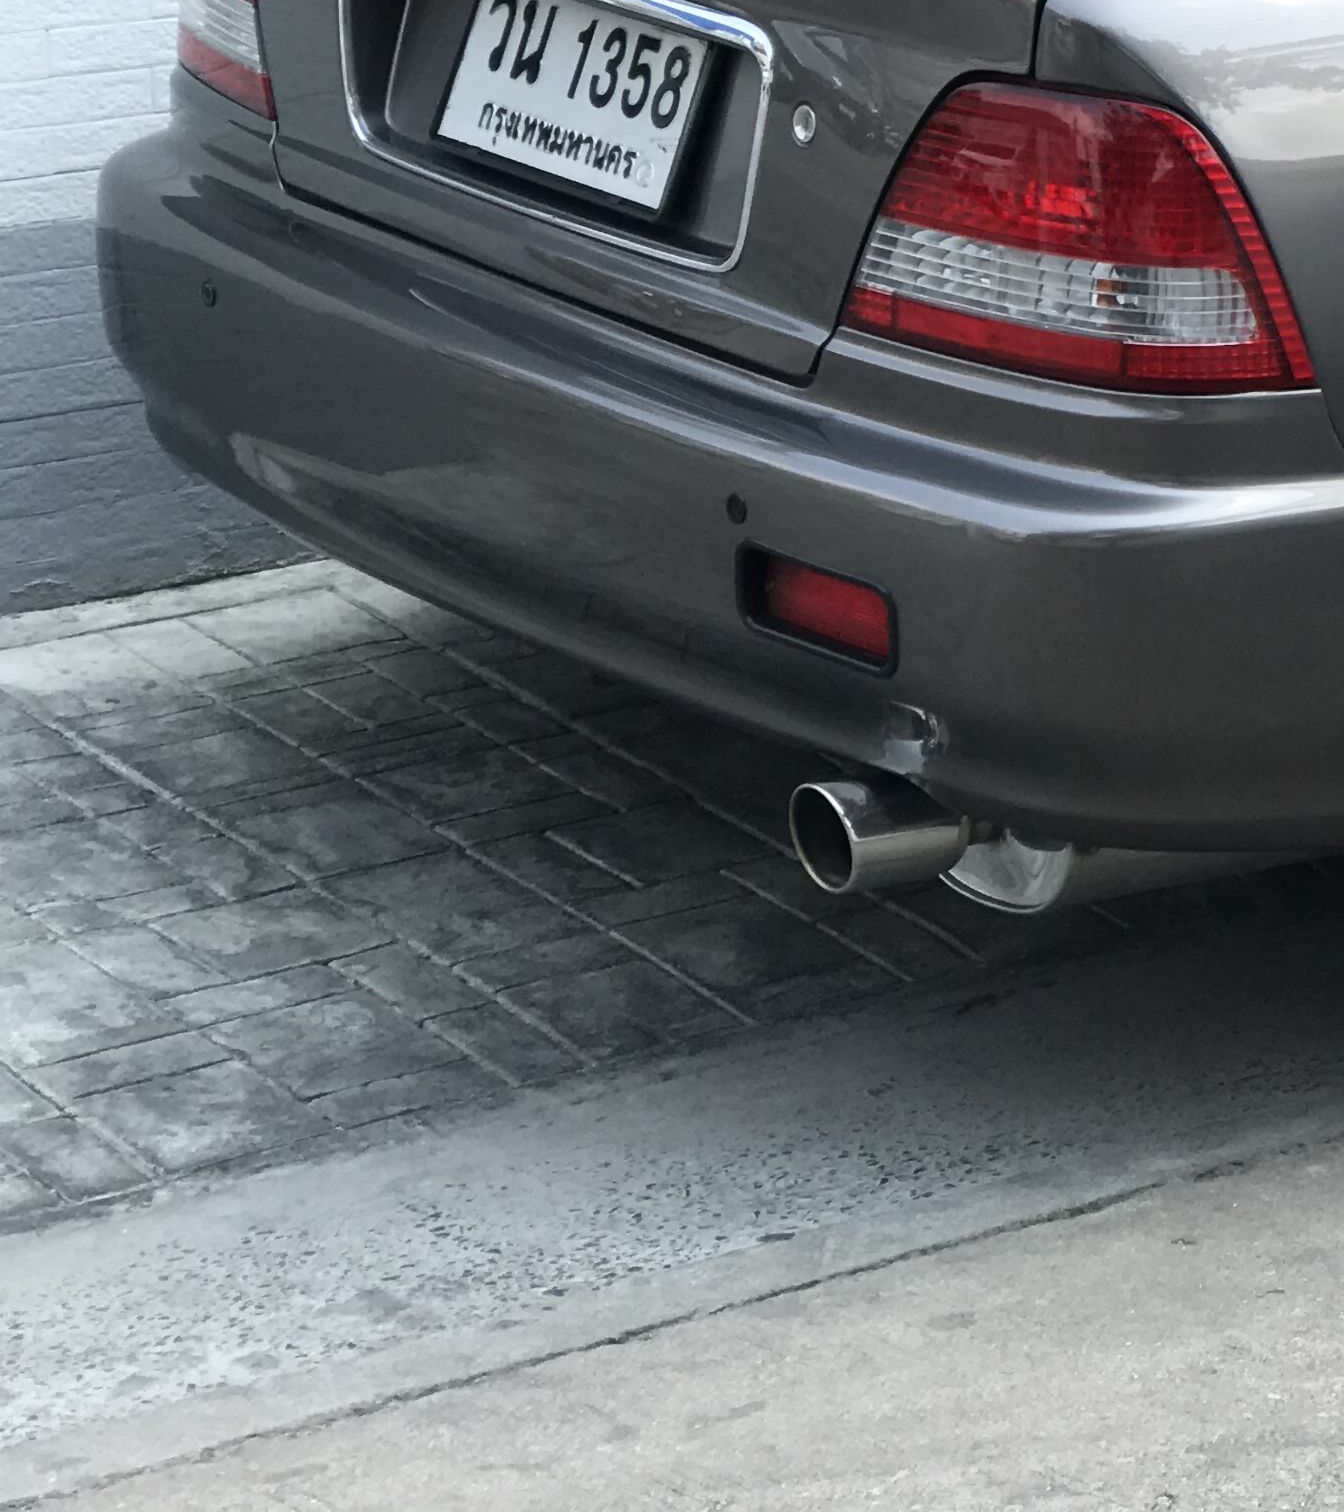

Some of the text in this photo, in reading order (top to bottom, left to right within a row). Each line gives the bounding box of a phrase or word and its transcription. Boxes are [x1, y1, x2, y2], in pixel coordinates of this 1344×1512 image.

[566, 18, 692, 130] 1358
[477, 100, 638, 181] กรุงเทพมหานคร
